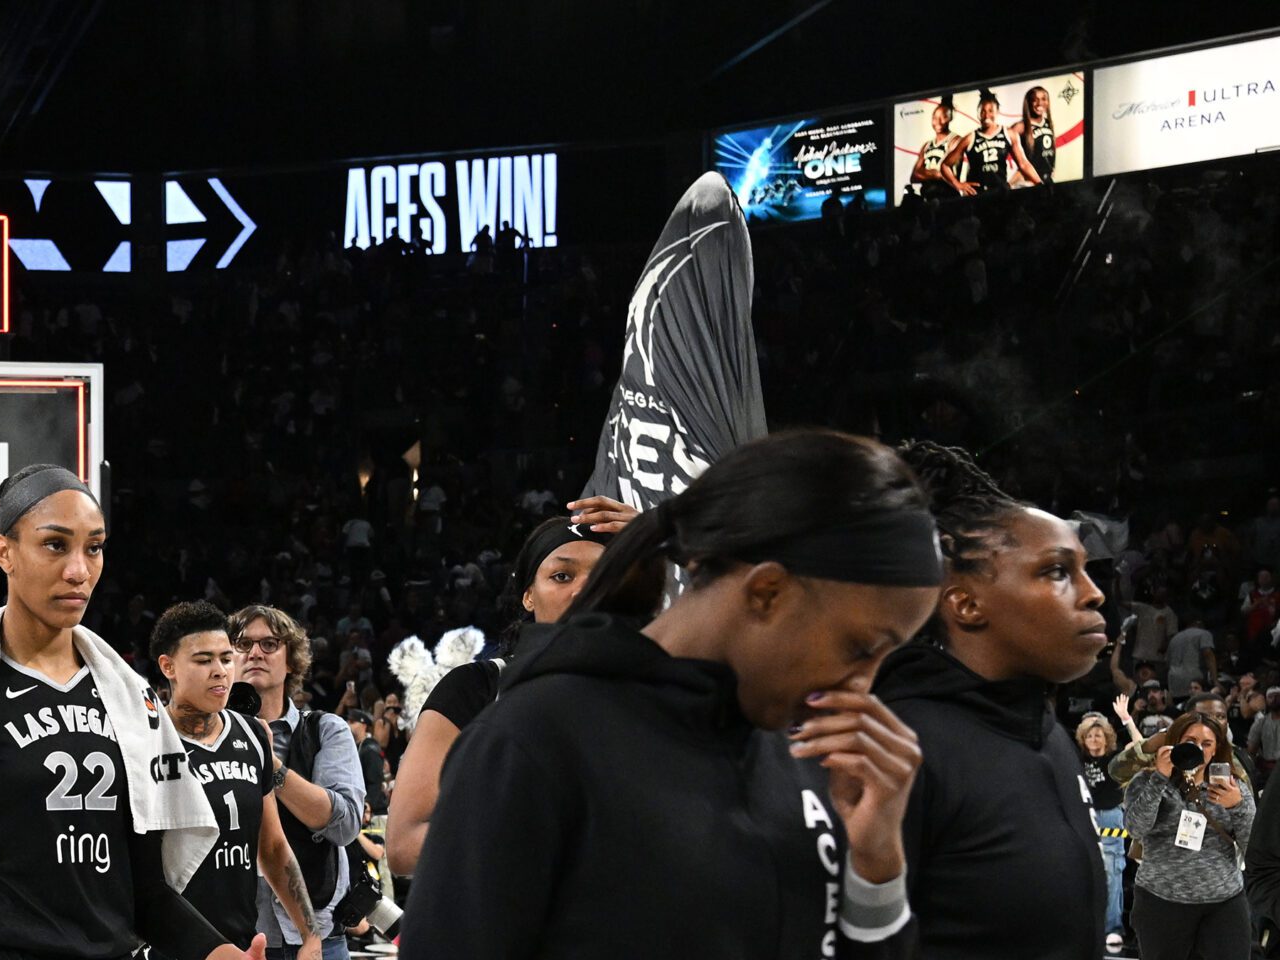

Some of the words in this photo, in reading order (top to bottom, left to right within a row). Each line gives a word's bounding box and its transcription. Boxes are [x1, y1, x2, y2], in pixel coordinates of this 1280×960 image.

[1203, 79, 1276, 103] ULTRA
[1160, 111, 1226, 132] ARENA
[982, 147, 999, 164] 12
[1042, 135, 1052, 149] 0
[804, 152, 862, 179] ONE
[343, 161, 447, 255] ACES
[455, 153, 558, 253] WIN!
[4, 706, 61, 749] LAS
[56, 704, 119, 743] VEGA
[43, 751, 118, 811] 22
[209, 760, 258, 785] VEGAS
[222, 789, 241, 831] 1
[56, 825, 111, 873] ring
[215, 841, 251, 870] ring
